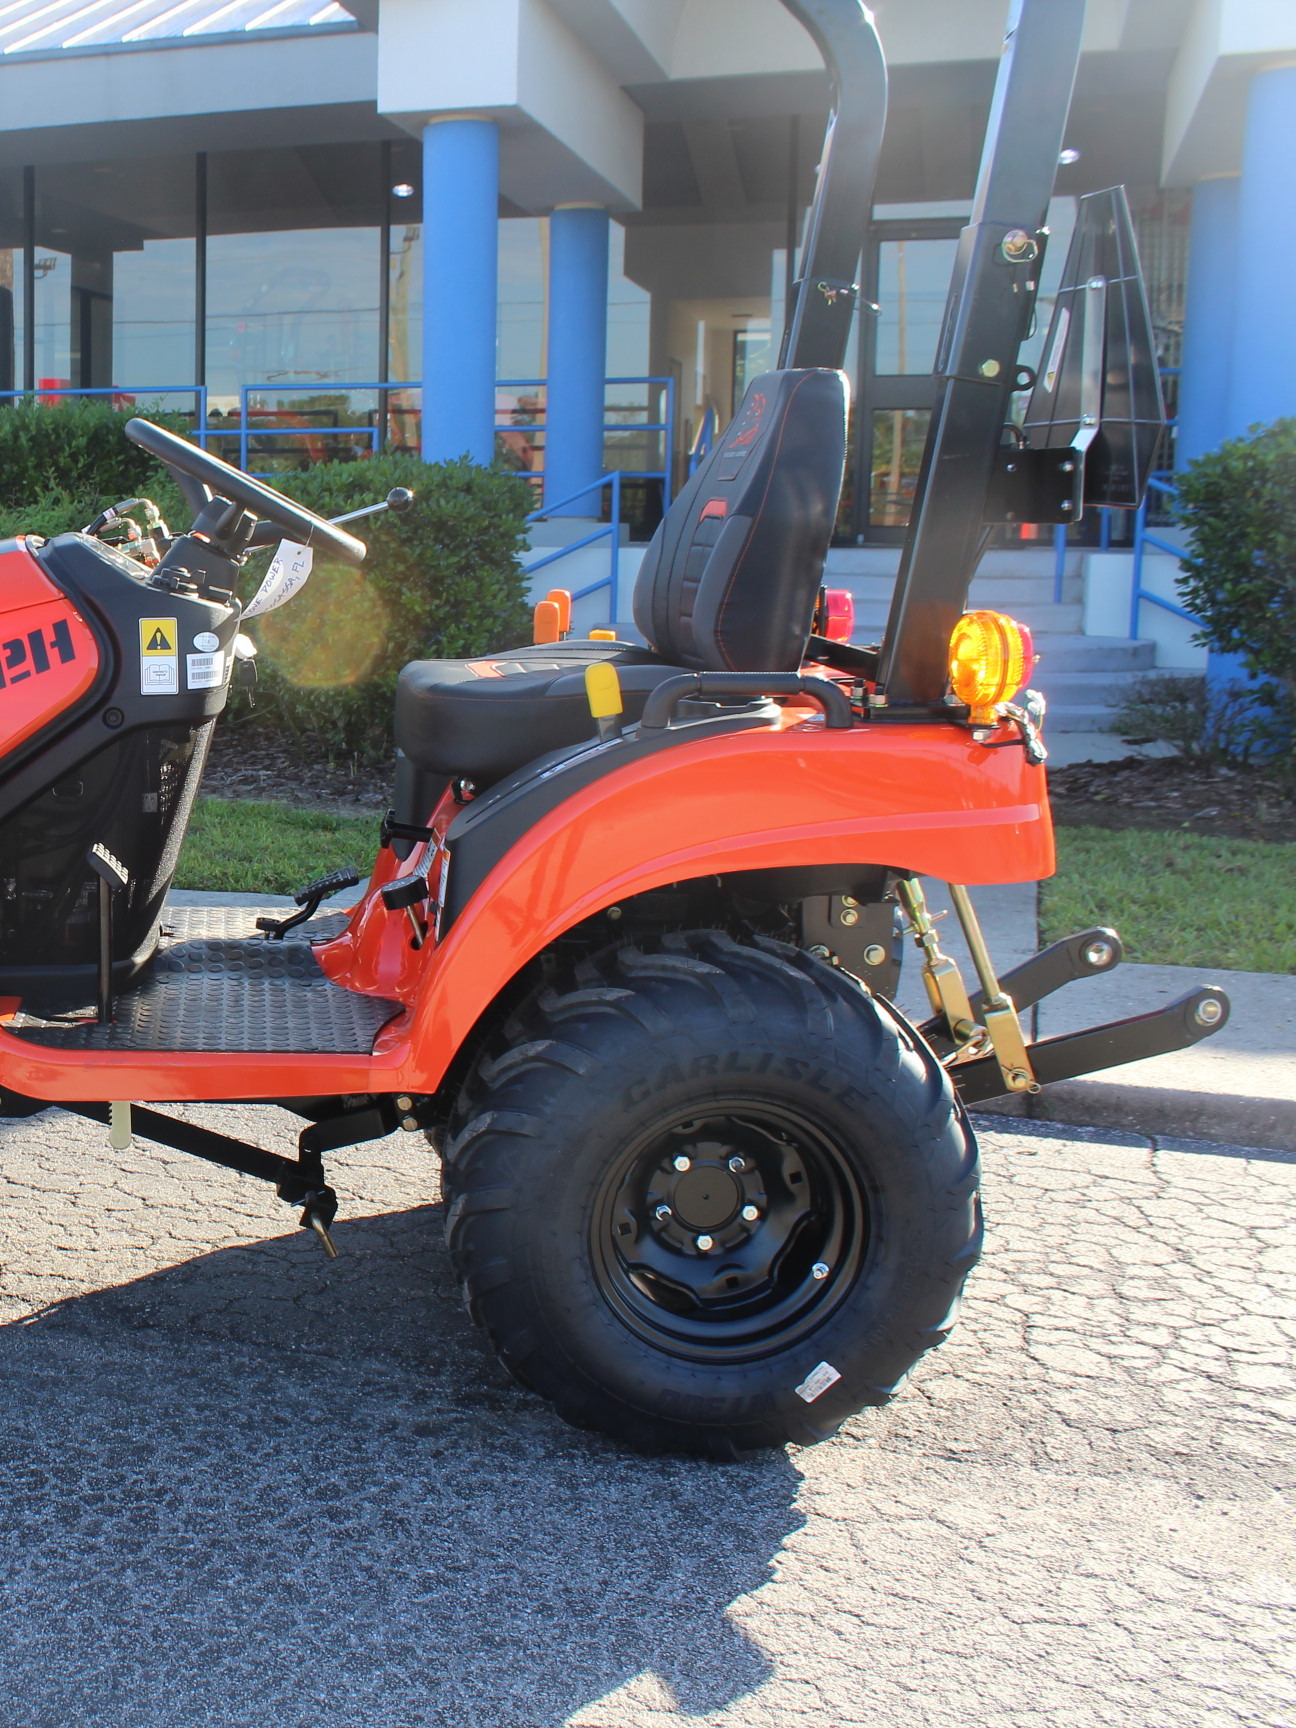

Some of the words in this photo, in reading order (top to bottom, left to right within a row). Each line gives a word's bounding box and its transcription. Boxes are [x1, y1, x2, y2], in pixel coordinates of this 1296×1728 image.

[261, 557, 284, 594] POWER
[292, 560, 305, 573] FL
[622, 1051, 870, 1113] CARLISLE
